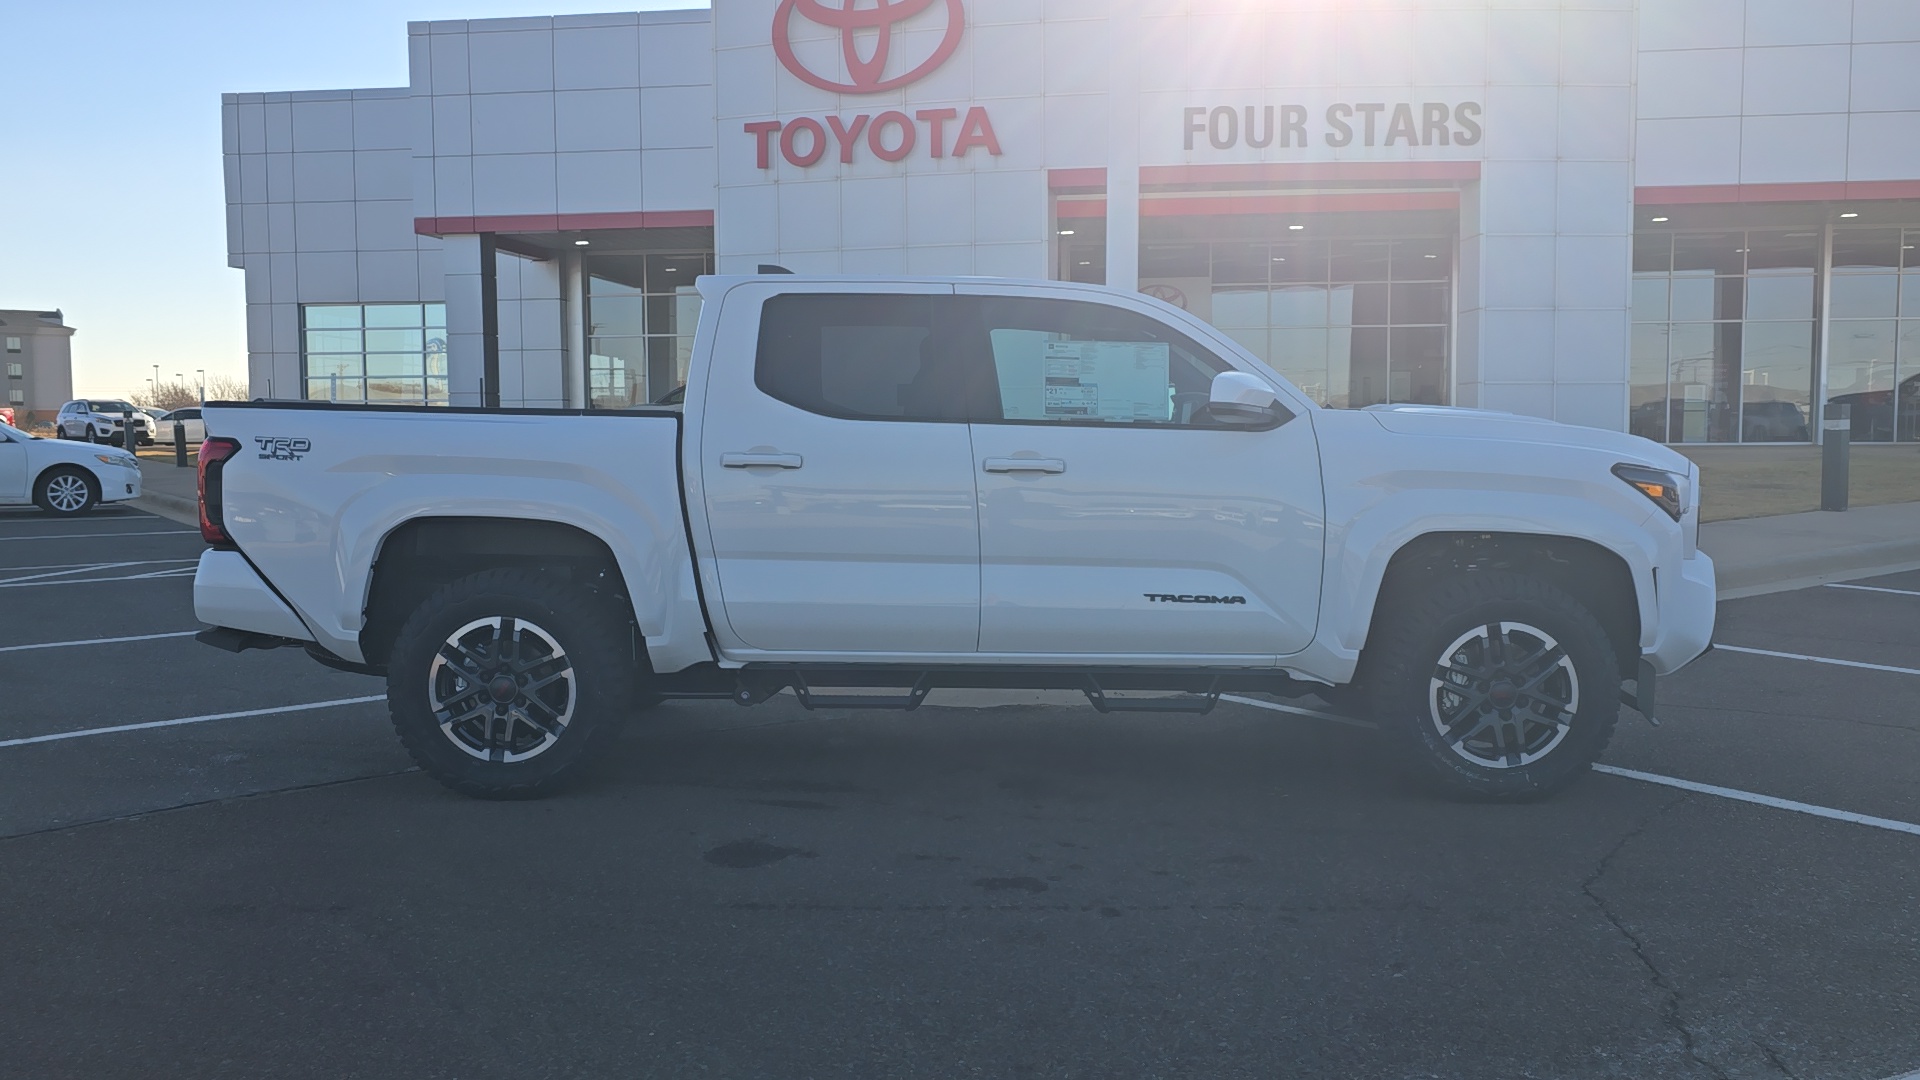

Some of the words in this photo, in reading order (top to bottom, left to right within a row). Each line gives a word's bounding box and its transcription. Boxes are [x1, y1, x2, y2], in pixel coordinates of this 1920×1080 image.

[1183, 104, 1308, 150] FOUR
[1324, 101, 1482, 147] STARS
[744, 106, 1002, 169] TOYOTA
[255, 436, 311, 456] TRD
[258, 453, 303, 461] SPORT
[1143, 593, 1246, 604] TACOMA
